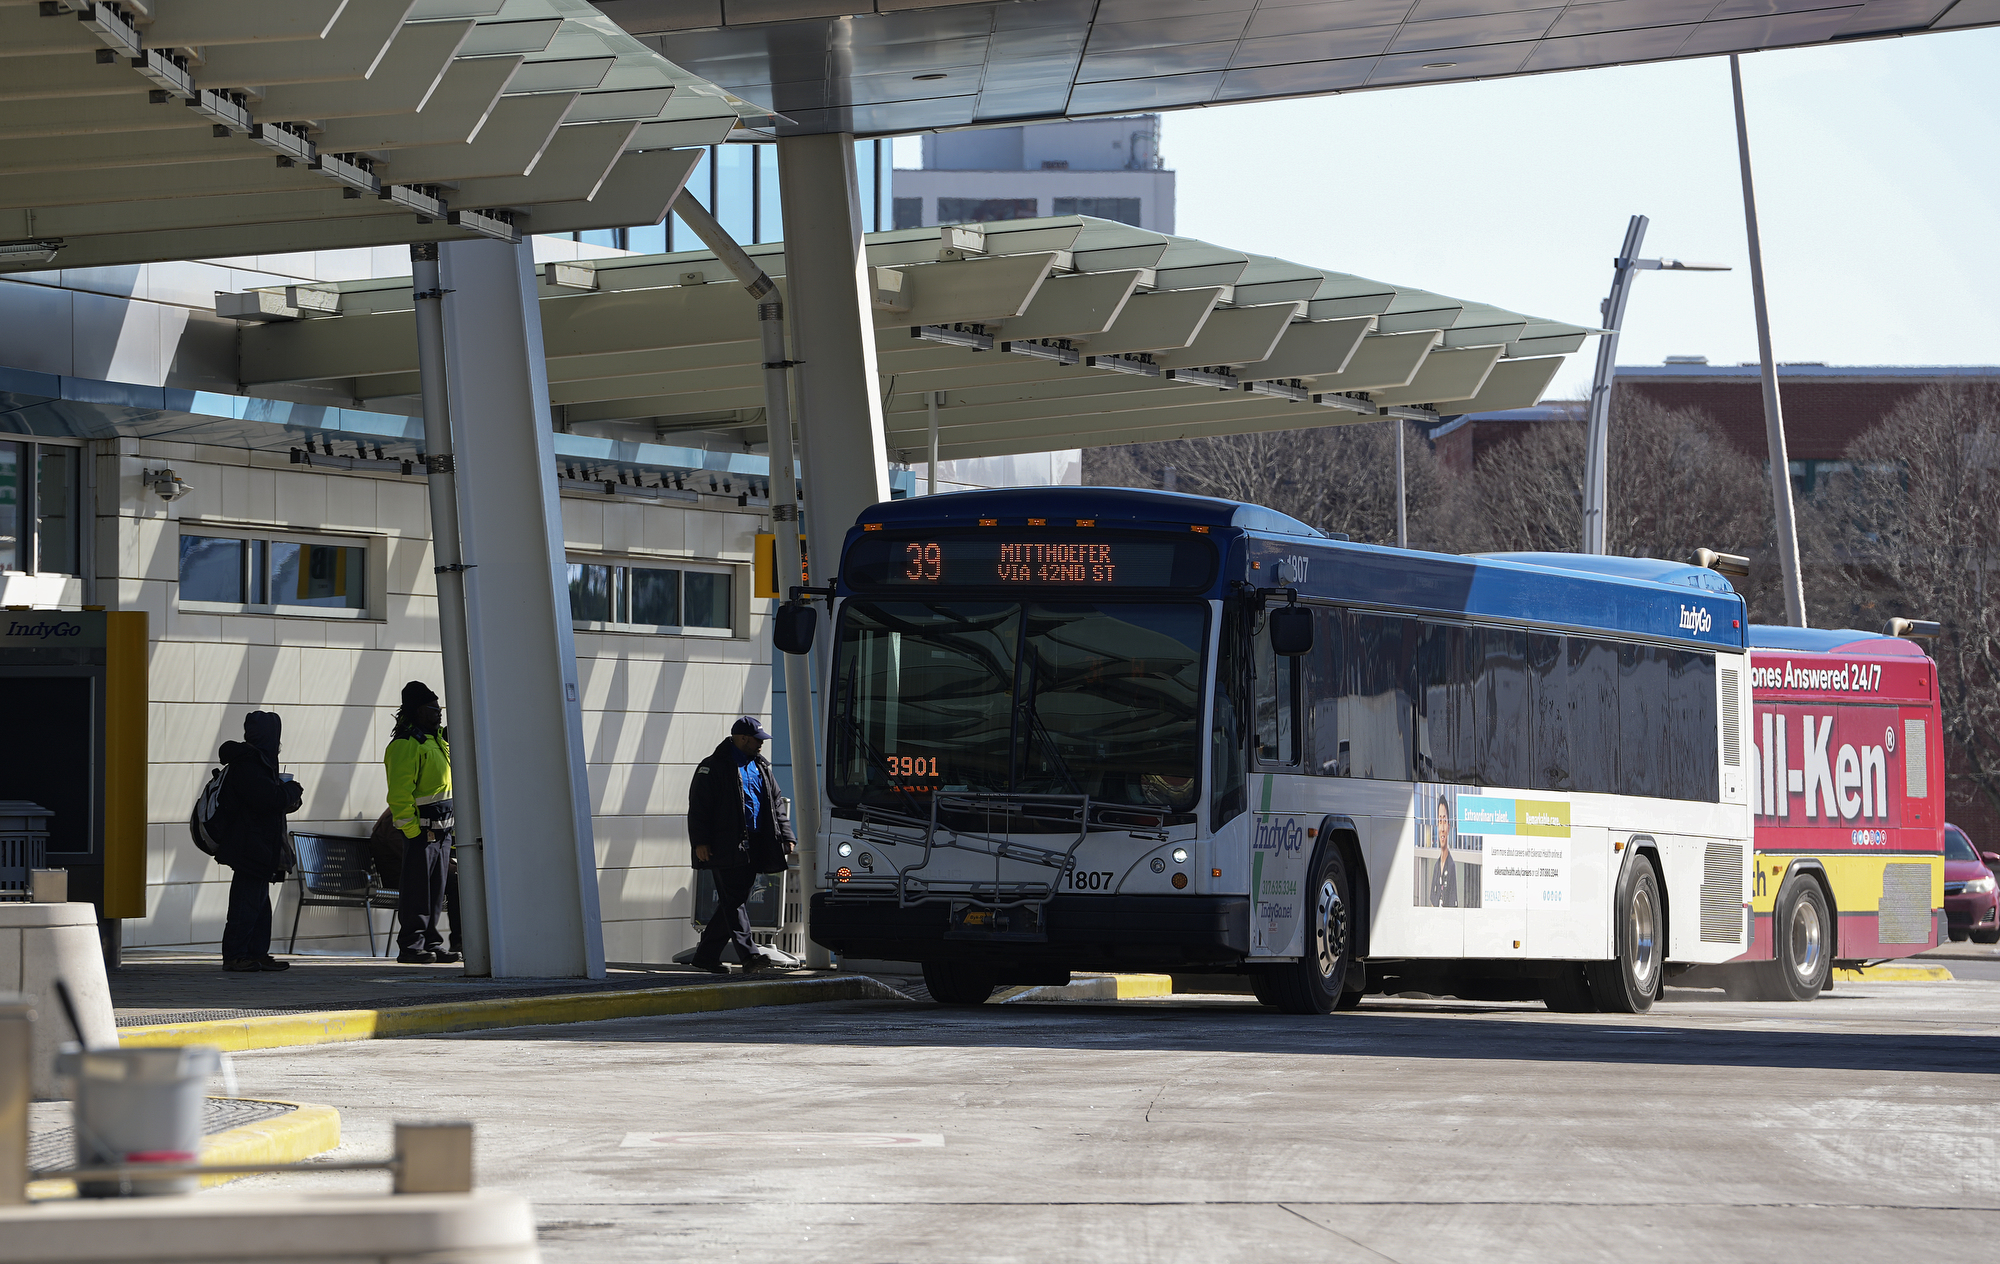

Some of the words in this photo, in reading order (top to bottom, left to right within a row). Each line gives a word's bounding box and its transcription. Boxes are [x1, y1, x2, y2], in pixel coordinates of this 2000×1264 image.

[905, 542, 942, 581] 39
[1000, 543, 1112, 563] MITTHOEFER
[997, 564, 1031, 582] VIA
[1037, 564, 1086, 582] 42ND
[1092, 564, 1116, 582] ST
[1679, 604, 1712, 636] IndyGo
[5, 621, 82, 640] IndyGo
[1783, 660, 1850, 691] Answered
[1851, 663, 1883, 692] 24/7
[886, 756, 940, 778] 3901
[1464, 807, 1494, 825] Extraordinary
[1494, 809, 1509, 822] talent.
[1525, 811, 1550, 826] Remarkable
[1253, 818, 1303, 858] IndyGo
[1064, 870, 1115, 891] 1807
[1262, 880, 1297, 896] 317.635.3344
[1261, 903, 1293, 922] IndyGo.net
